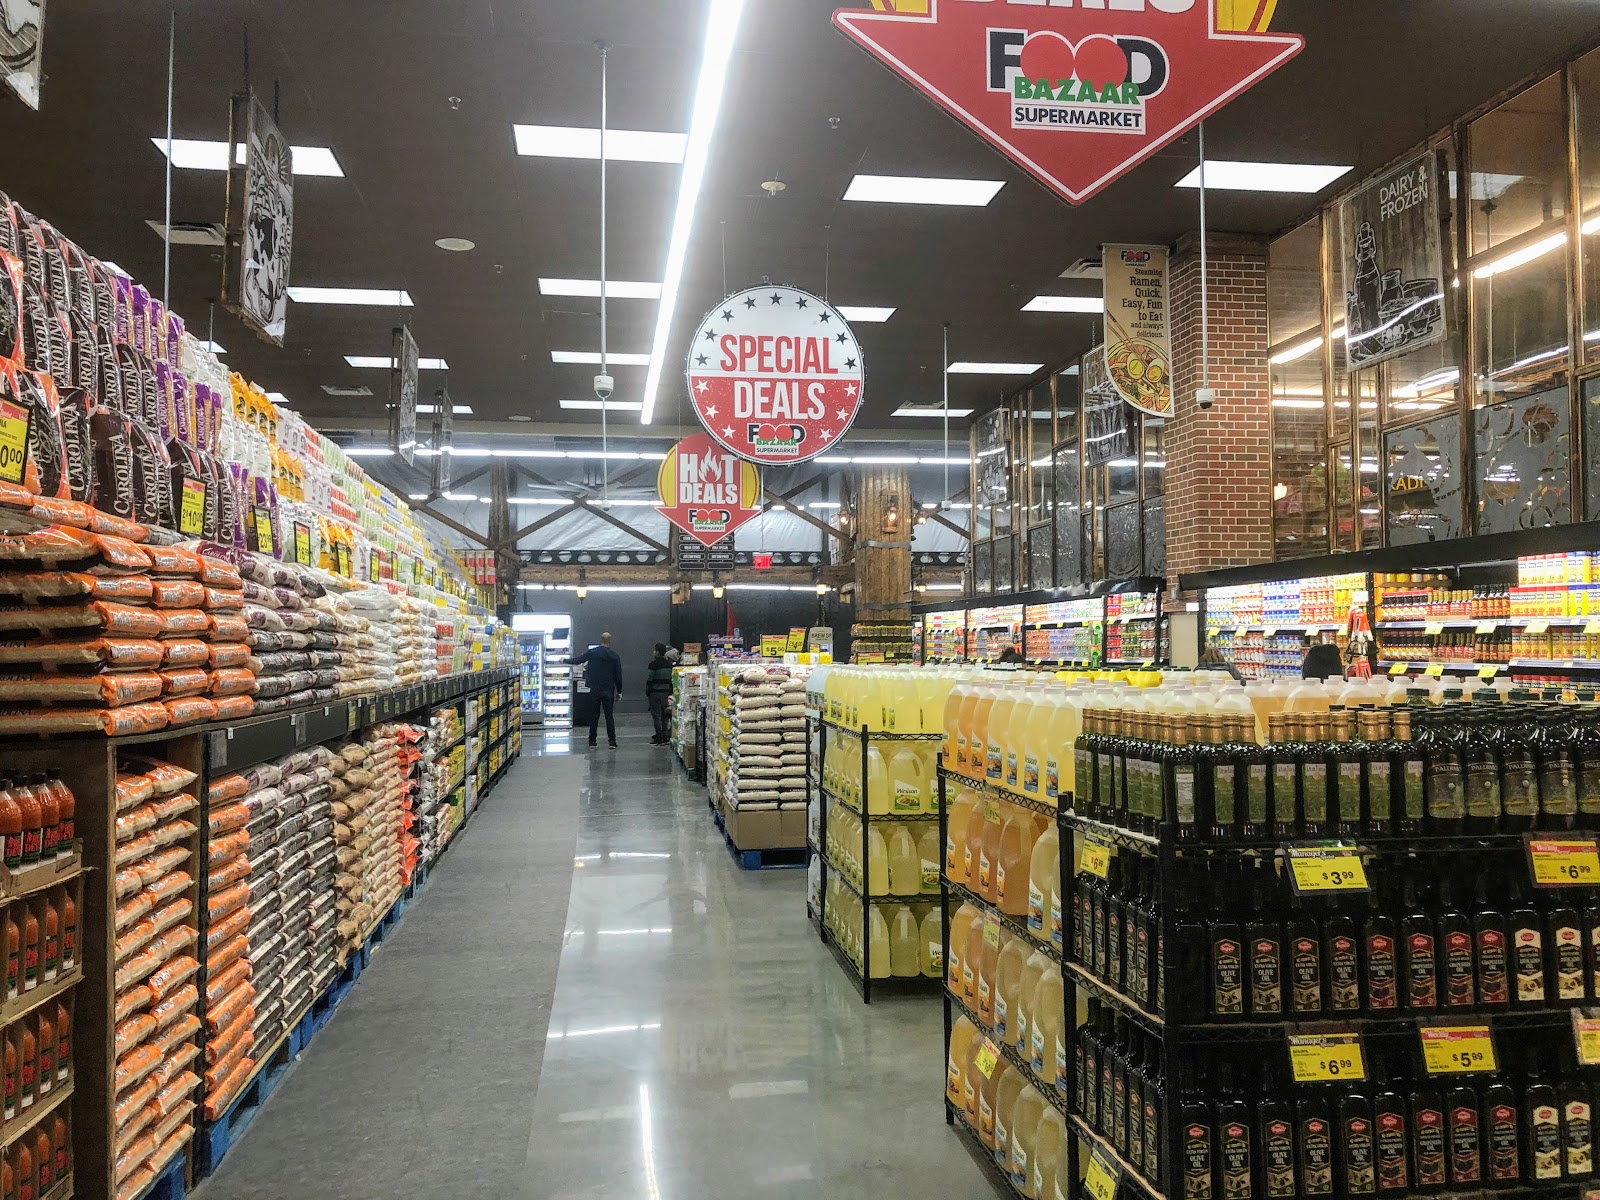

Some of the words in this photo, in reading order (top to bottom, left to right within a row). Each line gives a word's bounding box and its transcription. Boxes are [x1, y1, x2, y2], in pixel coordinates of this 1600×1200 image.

[987, 27, 1169, 100] FOOD
[1014, 76, 1140, 105] BAZAAR
[1014, 107, 1142, 128] SUPERMARKET
[1380, 170, 1415, 204] DAIRY
[1419, 166, 1428, 182] &
[1381, 182, 1428, 221] FROZEN
[1121, 250, 1150, 261] FOOD
[1130, 277, 1162, 288] Ramen,
[1135, 268, 1162, 277] Steaming
[1122, 298, 1145, 311] Easy,
[1147, 299, 1162, 309] Fun
[1135, 287, 1162, 299] Quick,
[1139, 312, 1147, 320] to
[1149, 312, 1163, 321] Eat
[1143, 322, 1164, 332] always
[720, 334, 838, 374] SPECIAL
[734, 381, 825, 420] DEALS
[747, 423, 806, 443] FOOD
[756, 438, 797, 446] BAZAAR
[60, 403, 85, 491] CAROLINA
[109, 434, 130, 514] CAROLINA
[680, 448, 738, 483] HOT
[136, 444, 157, 517] CAROLINA
[201, 473, 215, 537] CAROLINA
[680, 483, 738, 504] DEALS
[218, 479, 234, 540] CAROLINA
[688, 509, 731, 524] FOOD
